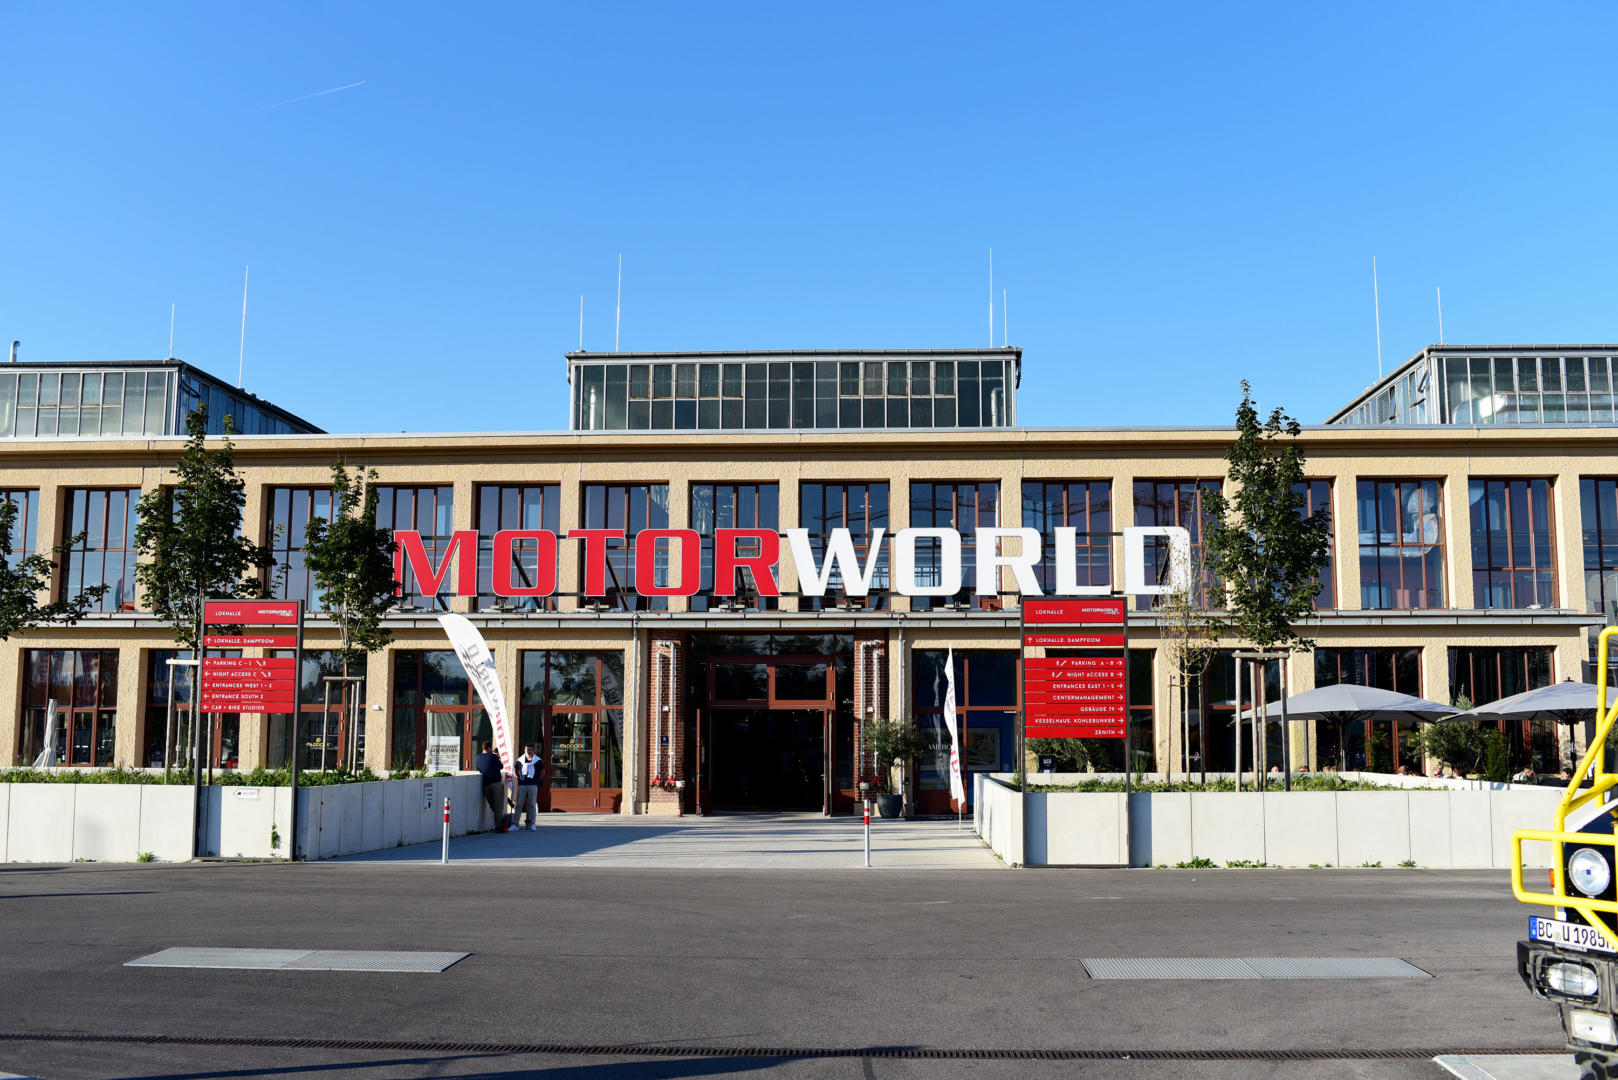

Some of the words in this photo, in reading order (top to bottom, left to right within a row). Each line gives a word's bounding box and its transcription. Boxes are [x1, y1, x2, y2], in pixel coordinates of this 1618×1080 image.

[393, 525, 1192, 597] MOTORWORLD
[1538, 921, 1553, 939] BC
[1562, 925, 1570, 942] U
